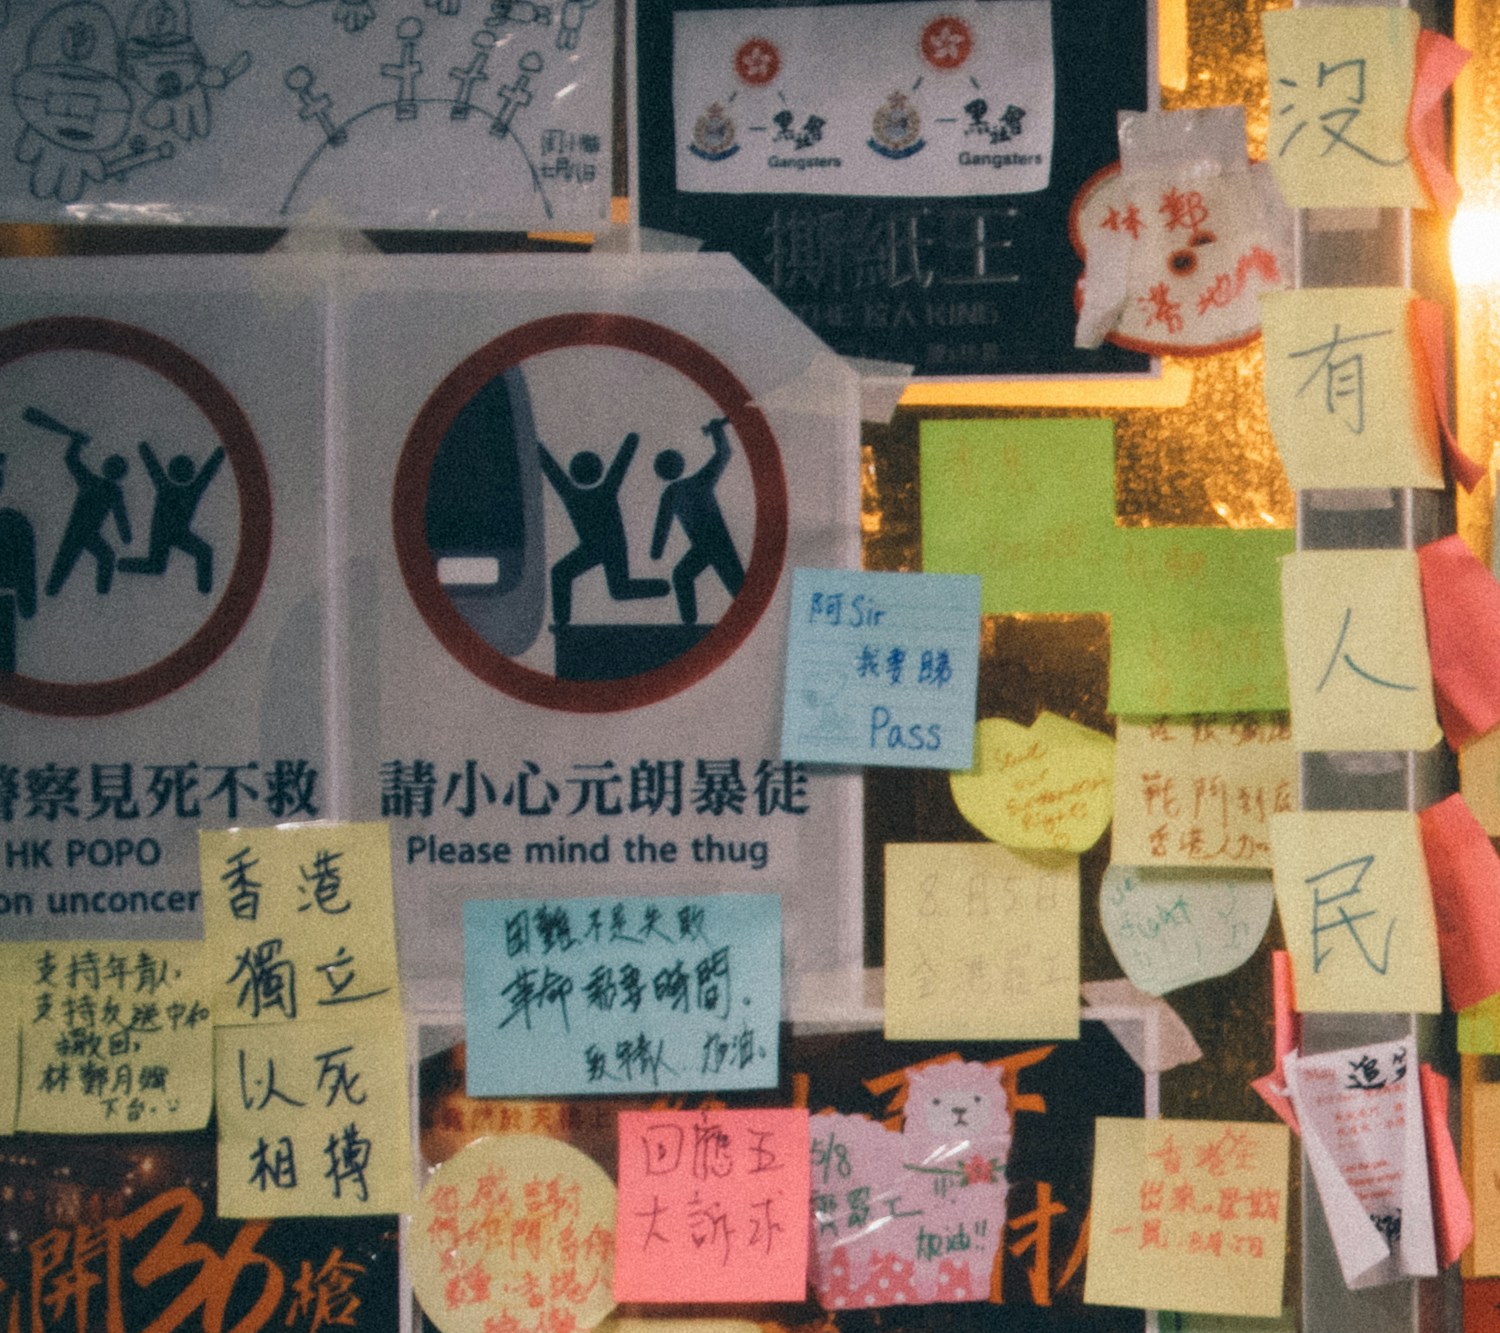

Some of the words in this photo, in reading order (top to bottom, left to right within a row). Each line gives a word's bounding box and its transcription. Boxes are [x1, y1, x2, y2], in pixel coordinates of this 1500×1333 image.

[767, 154, 842, 170] Gangsters
[958, 150, 1042, 168] Gangsters
[378, 760, 812, 822] 請小心元朗暴徒
[406, 835, 515, 866] Please
[524, 834, 615, 866] mind
[624, 836, 681, 867] the
[690, 837, 772, 876] thug
[239, 1046, 362, 1111] 以死
[250, 1122, 374, 1199] 相搏
[641, 1123, 784, 1182] 回應五
[637, 1203, 784, 1267] 大訴求
